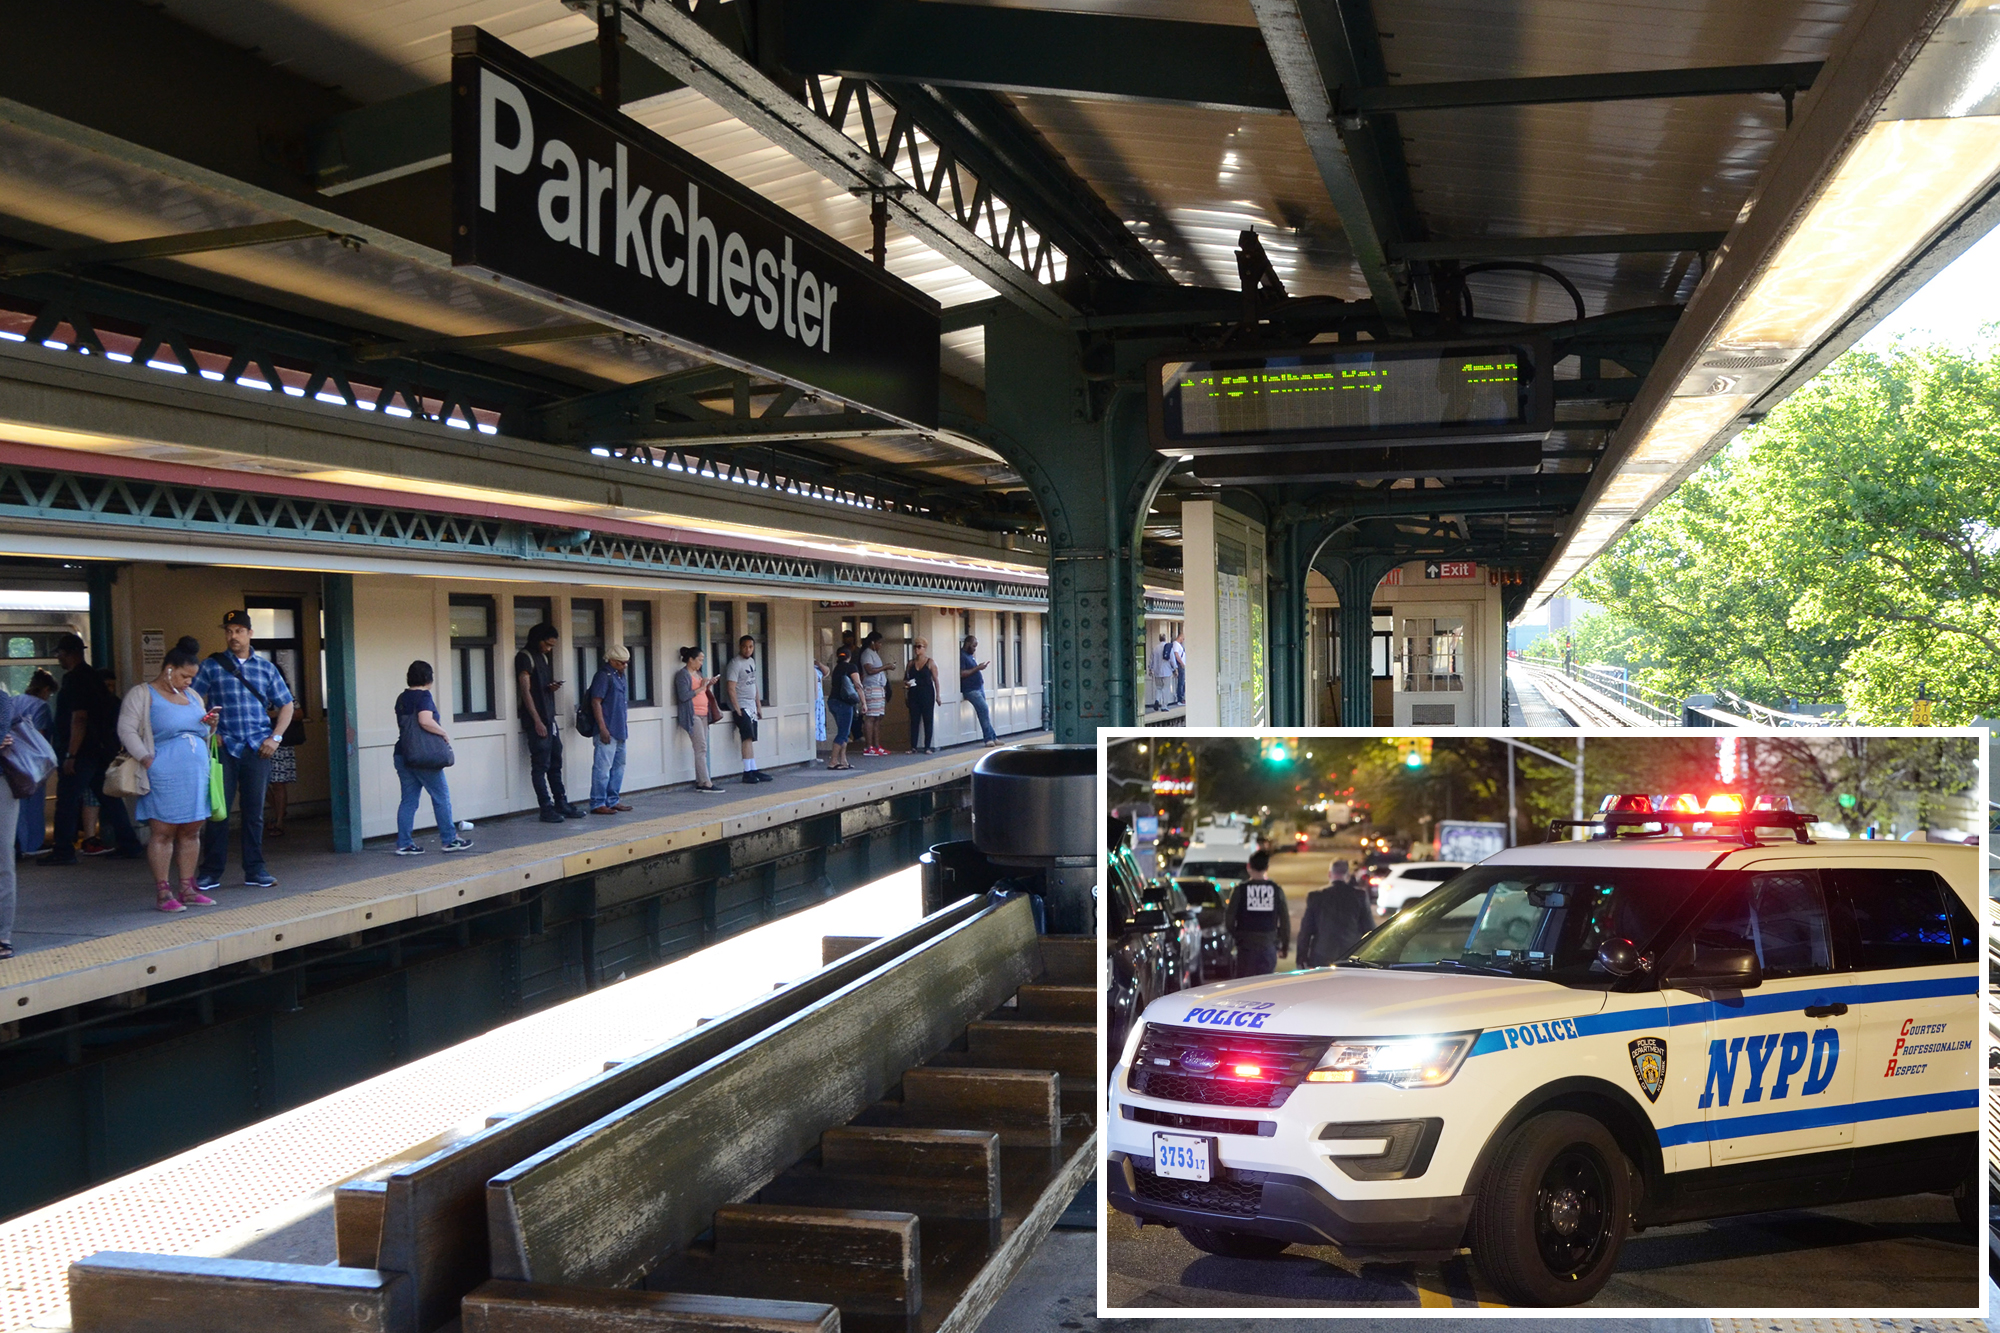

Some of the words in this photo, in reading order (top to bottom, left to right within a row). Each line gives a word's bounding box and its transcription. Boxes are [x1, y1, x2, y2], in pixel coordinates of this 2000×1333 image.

[480, 67, 838, 353] Parkchester
[1380, 568, 1401, 585] XIT
[1441, 563, 1469, 576] Exit
[228, 612, 235, 621] P
[1915, 714, 1928, 722] 20
[1246, 885, 1275, 898] NYPD
[1246, 897, 1275, 908] POLICE
[1182, 1007, 1271, 1028] POLICE
[1504, 1019, 1578, 1049] POLICE
[1637, 1039, 1656, 1047] POLICE
[1631, 1045, 1665, 1059] DEPARTMENT
[1697, 1027, 1840, 1109] NYPD
[1160, 1145, 1194, 1169] 3753
[1195, 1158, 1206, 1170] 17
